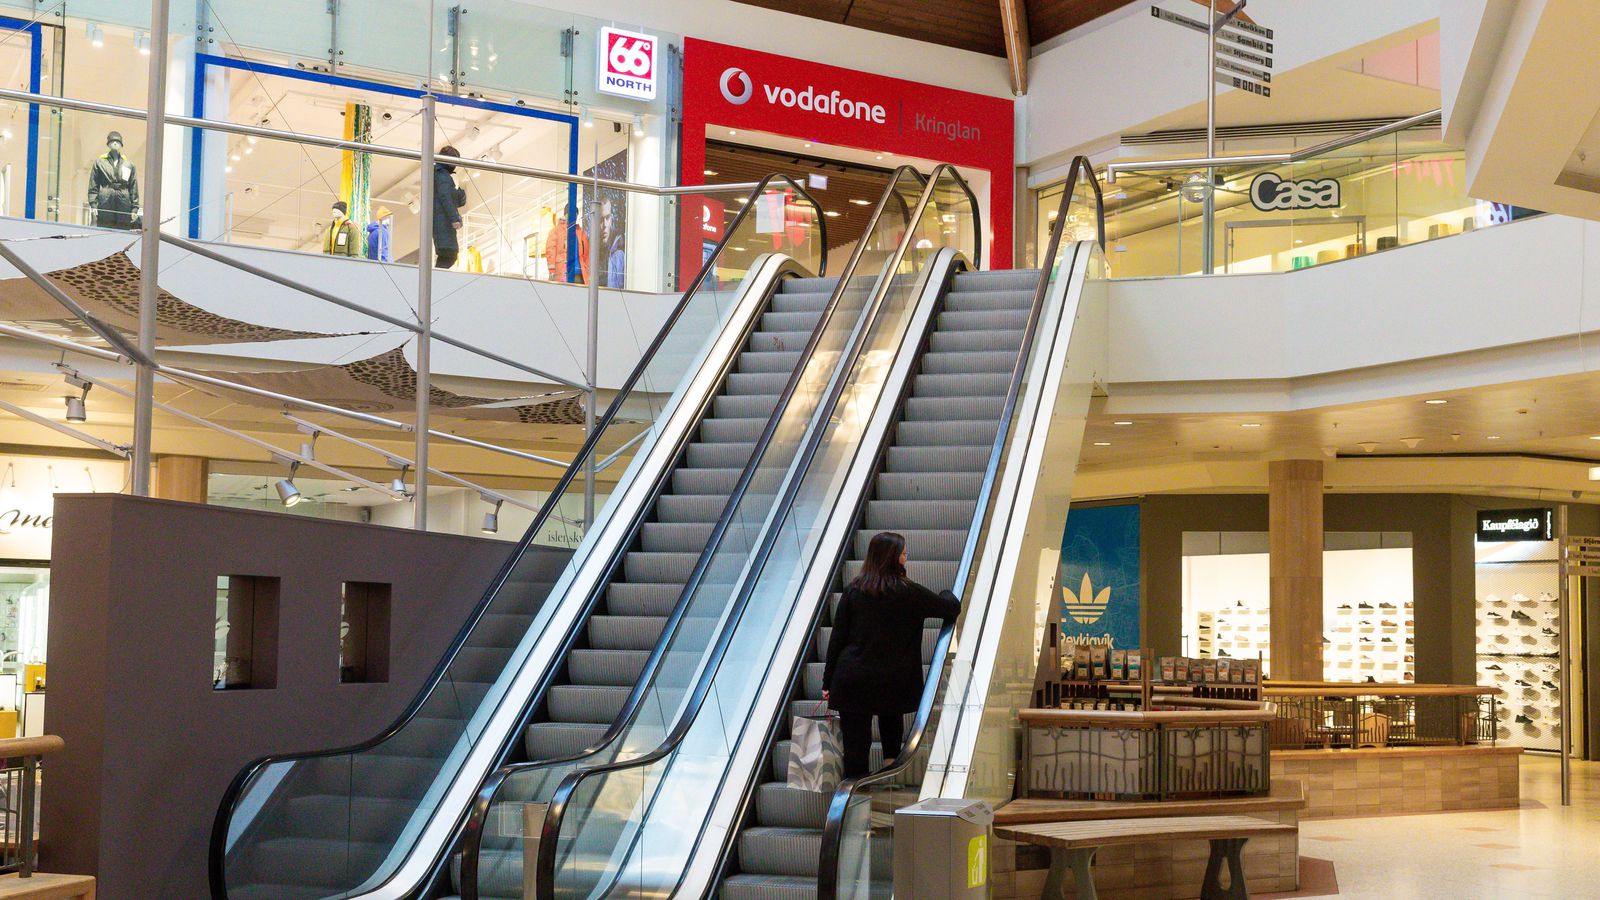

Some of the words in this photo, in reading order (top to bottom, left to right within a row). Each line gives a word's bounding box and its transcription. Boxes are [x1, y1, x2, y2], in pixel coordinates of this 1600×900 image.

[606, 76, 652, 92] NORTH
[763, 84, 886, 124] vodafone
[915, 113, 981, 141] Kringlan
[1249, 172, 1340, 212] Casa
[1482, 518, 1539, 532] Kaupfélagið
